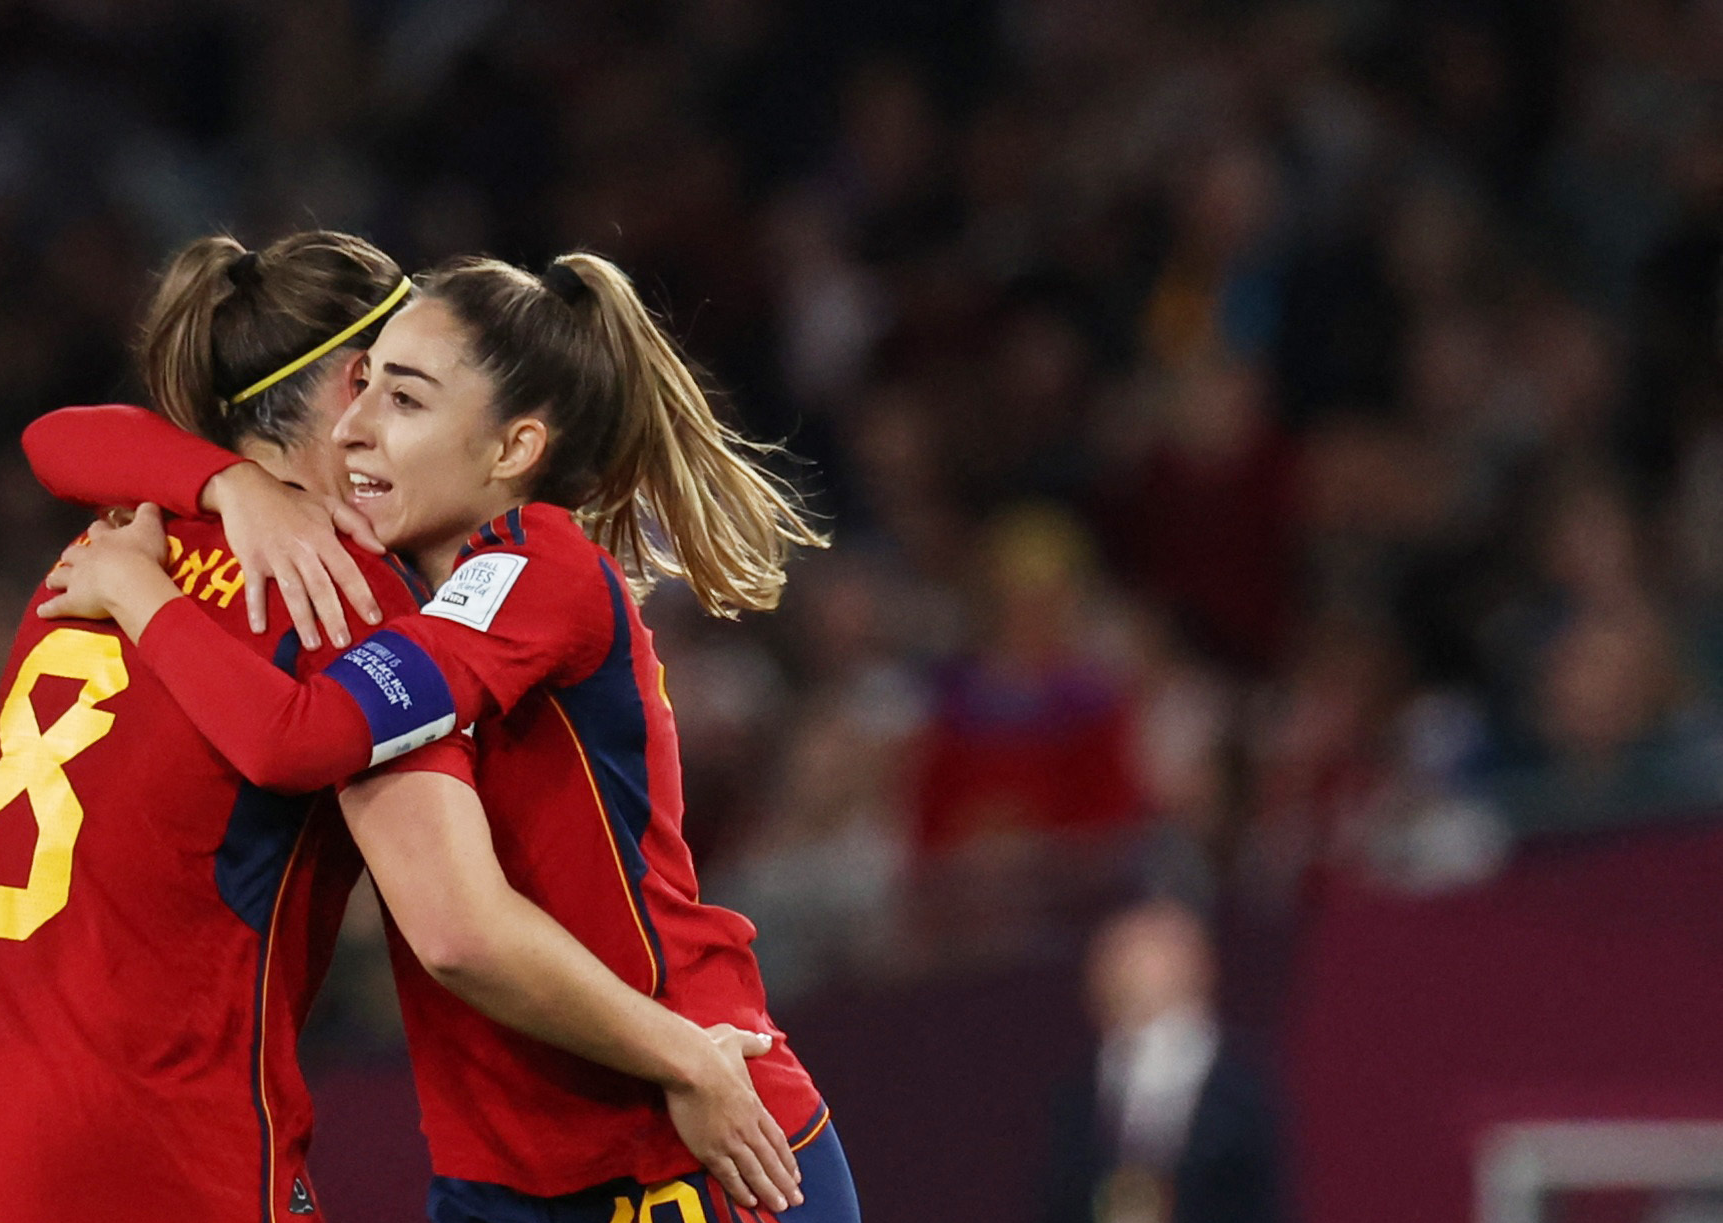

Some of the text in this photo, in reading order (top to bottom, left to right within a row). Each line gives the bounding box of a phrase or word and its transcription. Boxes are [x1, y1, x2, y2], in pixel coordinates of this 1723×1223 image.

[362, 663, 399, 705] PASSION
[367, 655, 396, 680] PEACE
[390, 678, 413, 710] HOPE
